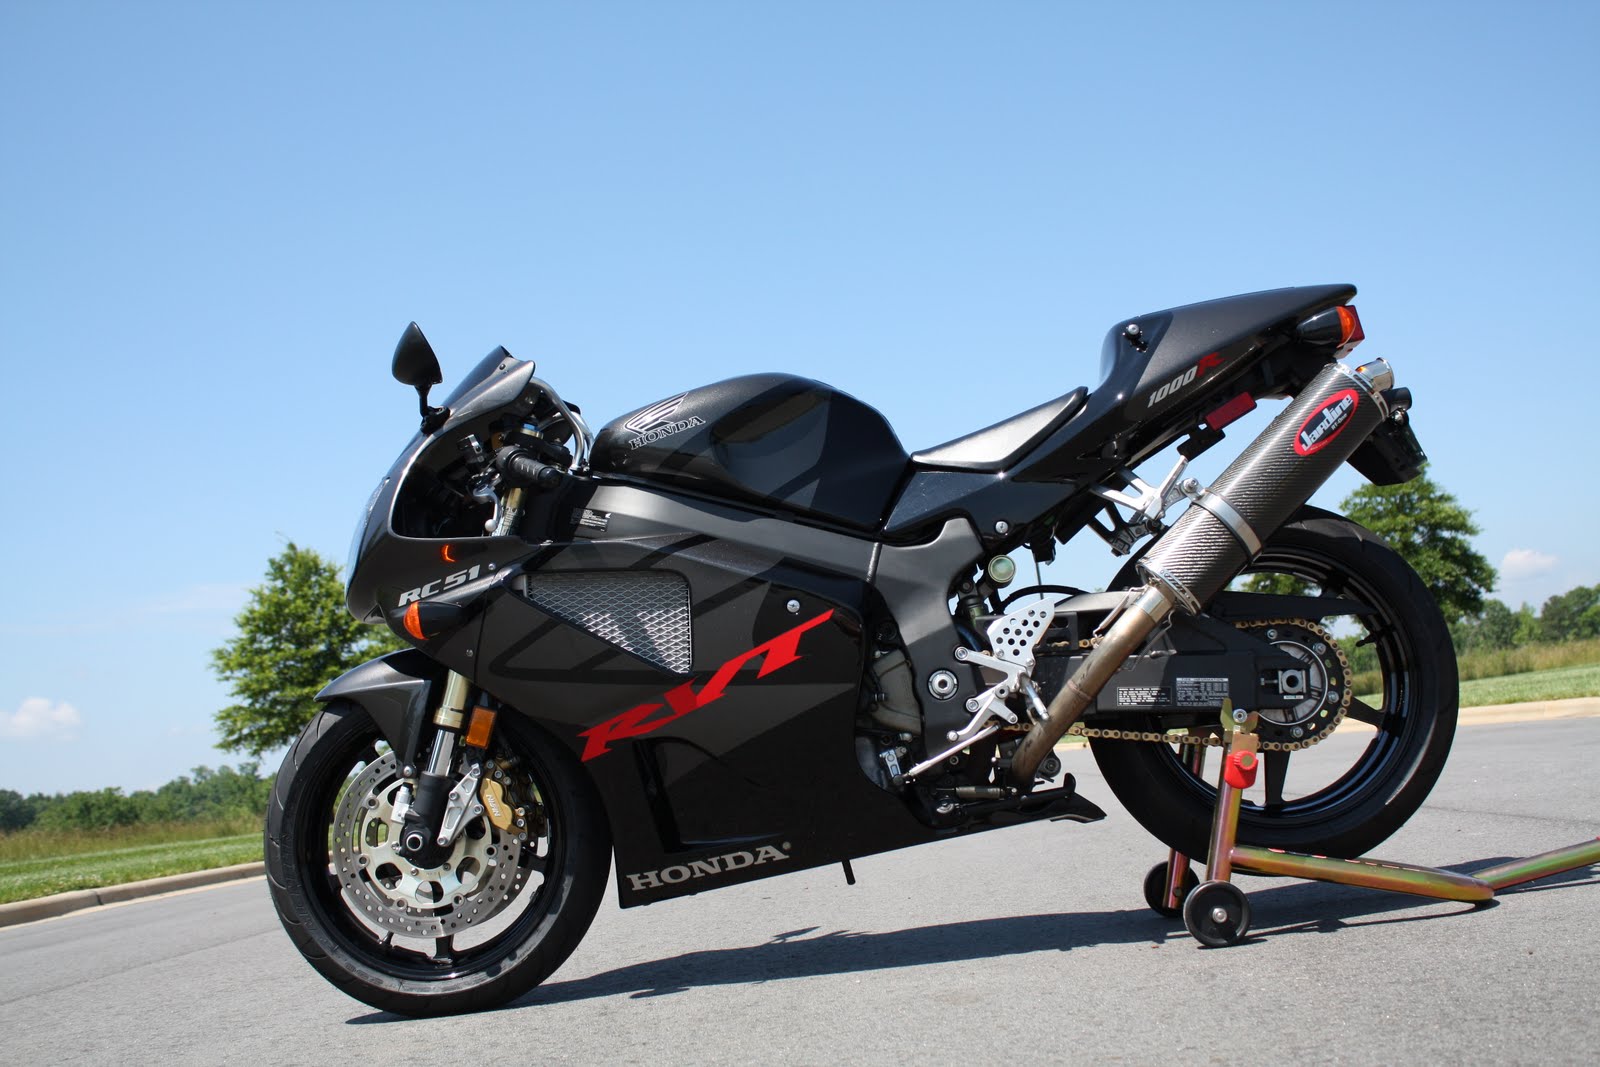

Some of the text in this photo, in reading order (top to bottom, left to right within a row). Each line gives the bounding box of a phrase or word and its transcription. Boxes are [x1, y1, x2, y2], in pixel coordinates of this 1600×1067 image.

[1147, 351, 1225, 408] 1000R
[628, 415, 706, 451] HONDA
[626, 845, 790, 891] HONDA
